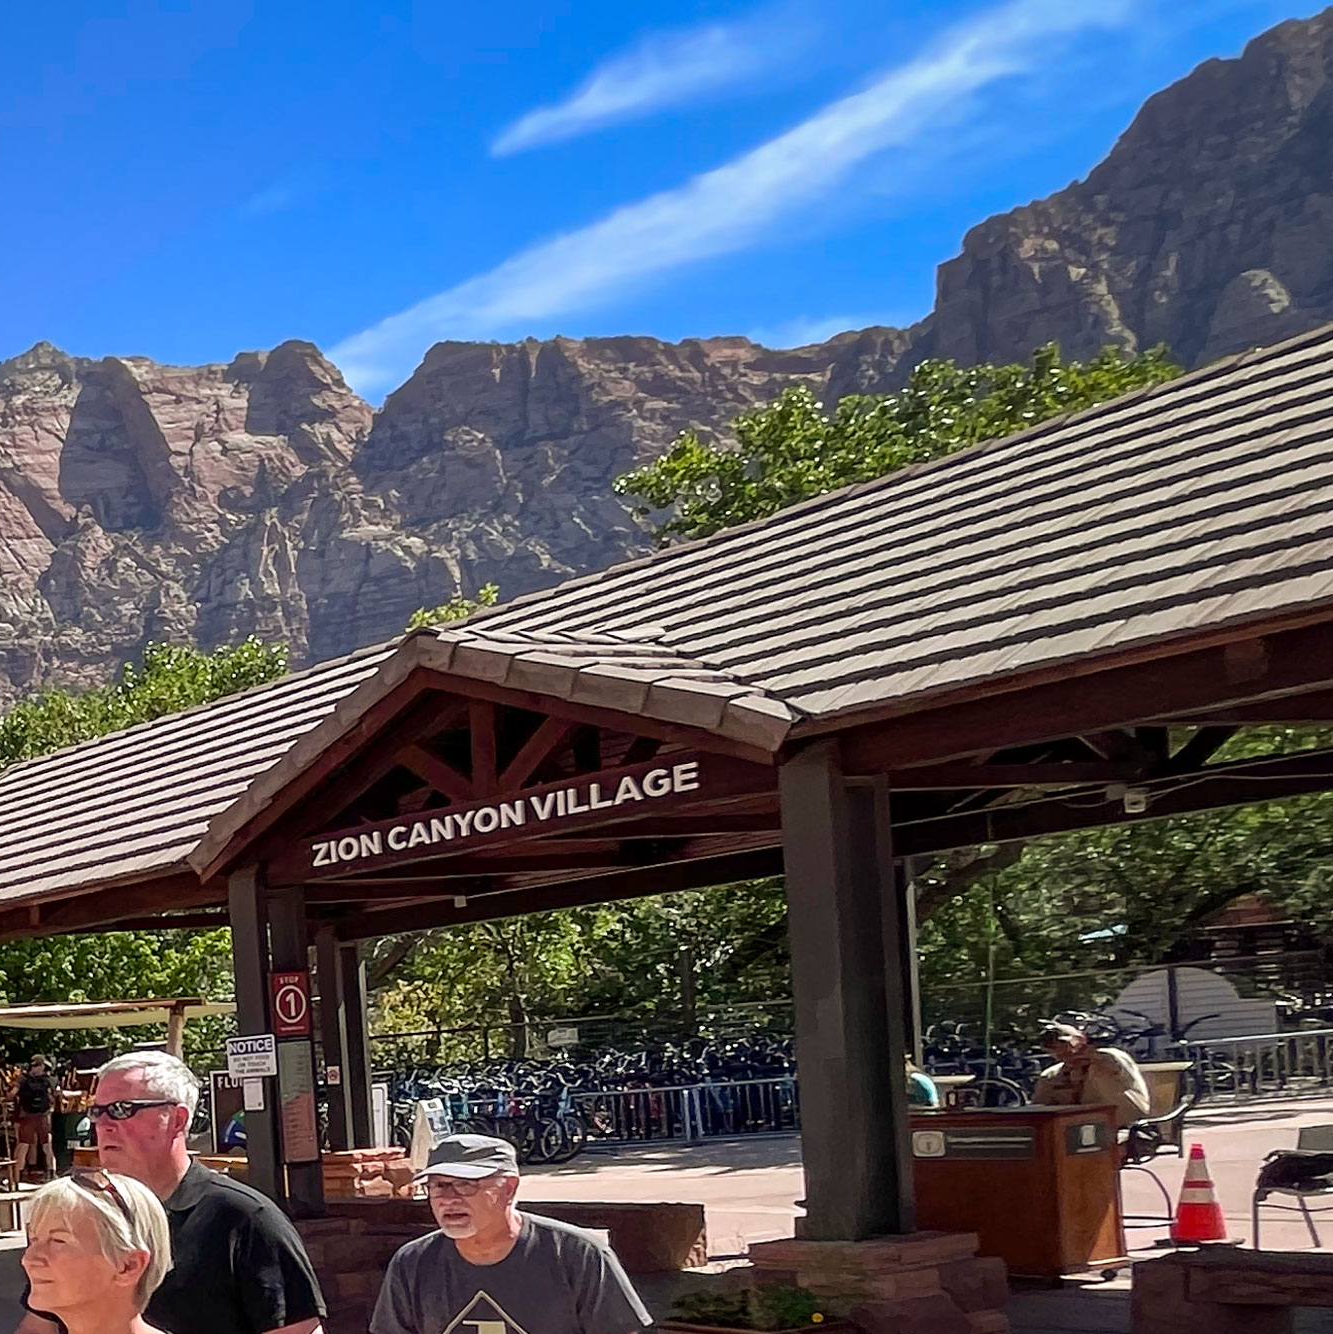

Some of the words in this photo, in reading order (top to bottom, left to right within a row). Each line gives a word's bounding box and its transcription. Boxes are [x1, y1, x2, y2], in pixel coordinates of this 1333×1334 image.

[312, 830, 382, 867] ZION
[387, 800, 526, 852] CANYON
[530, 761, 701, 822] VILLAGE
[279, 976, 299, 985] STOP
[285, 992, 297, 1017] 1
[229, 1039, 273, 1054] NOTICE
